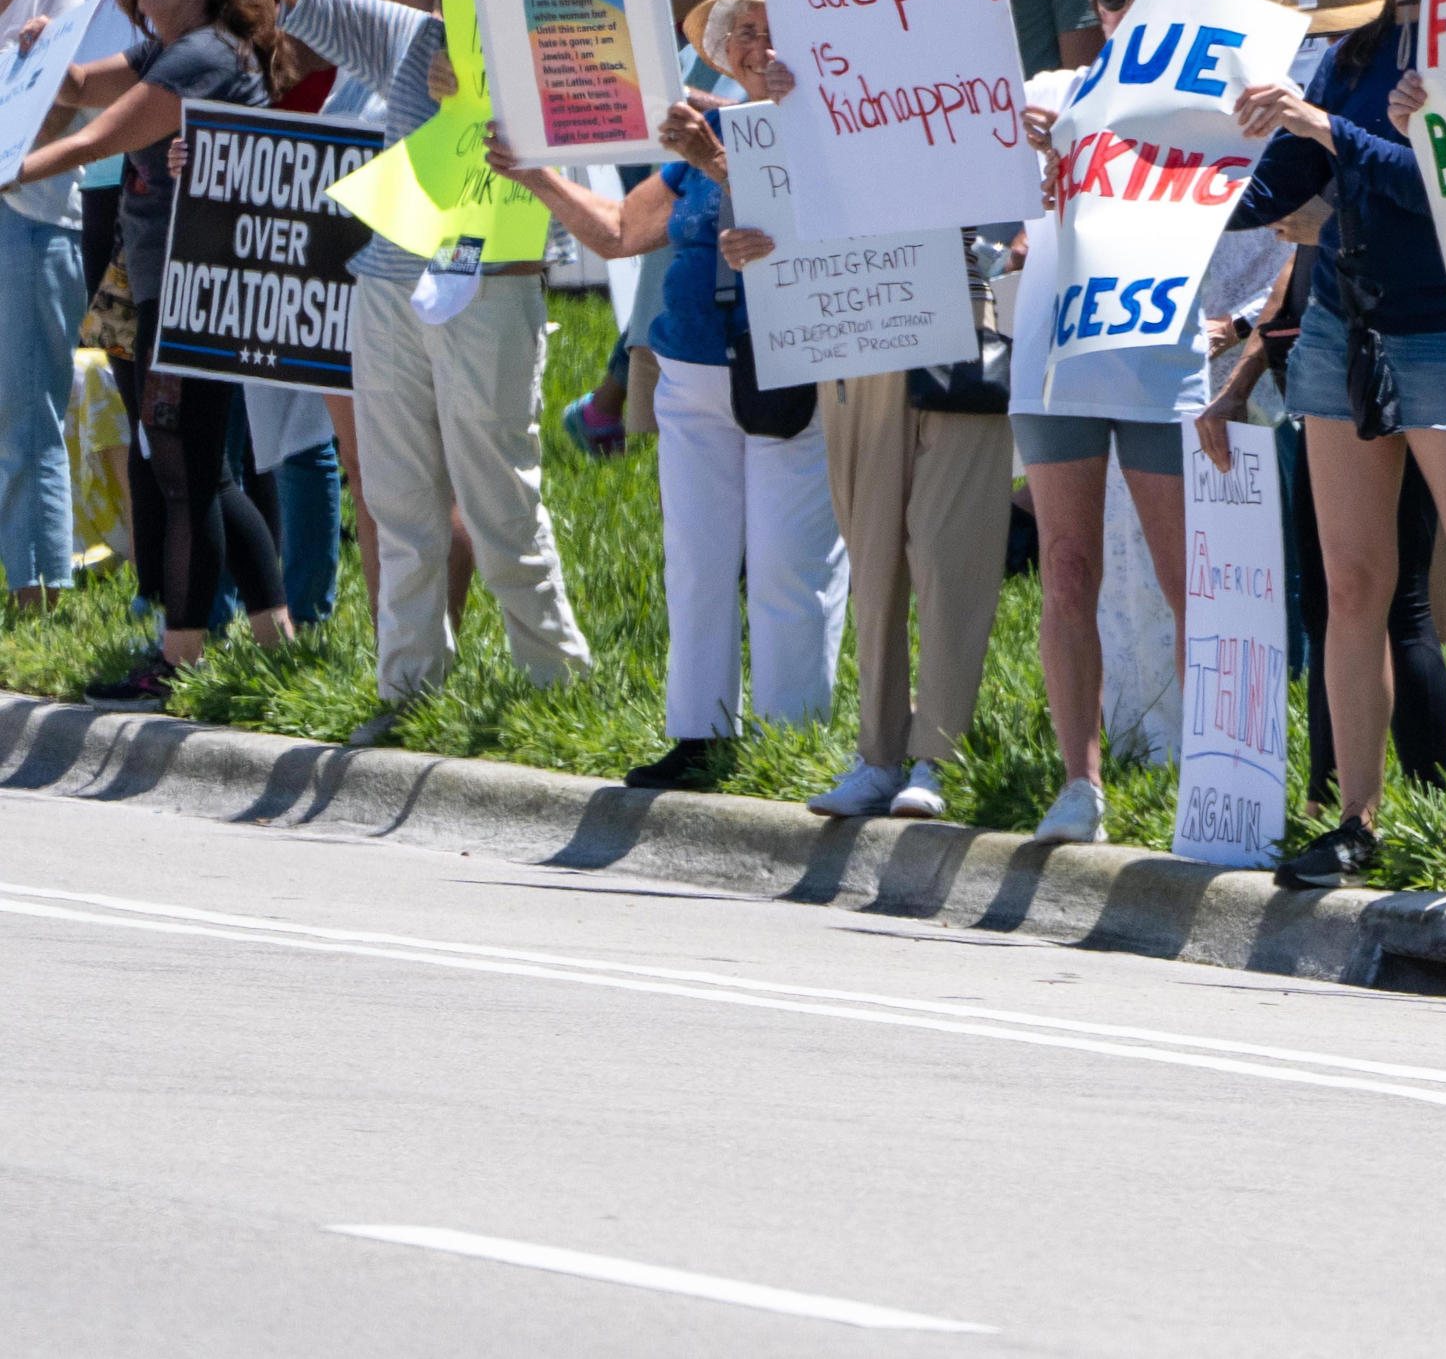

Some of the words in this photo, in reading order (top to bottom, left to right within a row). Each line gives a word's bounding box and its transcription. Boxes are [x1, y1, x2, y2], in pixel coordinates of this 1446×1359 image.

[811, 40, 849, 77] is
[731, 116, 776, 153] NO
[233, 213, 309, 266] OVER
[770, 244, 924, 288] IMMIGRANT
[808, 281, 914, 317] RIGHTS
[1051, 277, 1190, 354] CESS
[769, 330, 795, 352] NO
[1188, 633, 1285, 761] THINK
[1181, 786, 1263, 853] AGAIN
